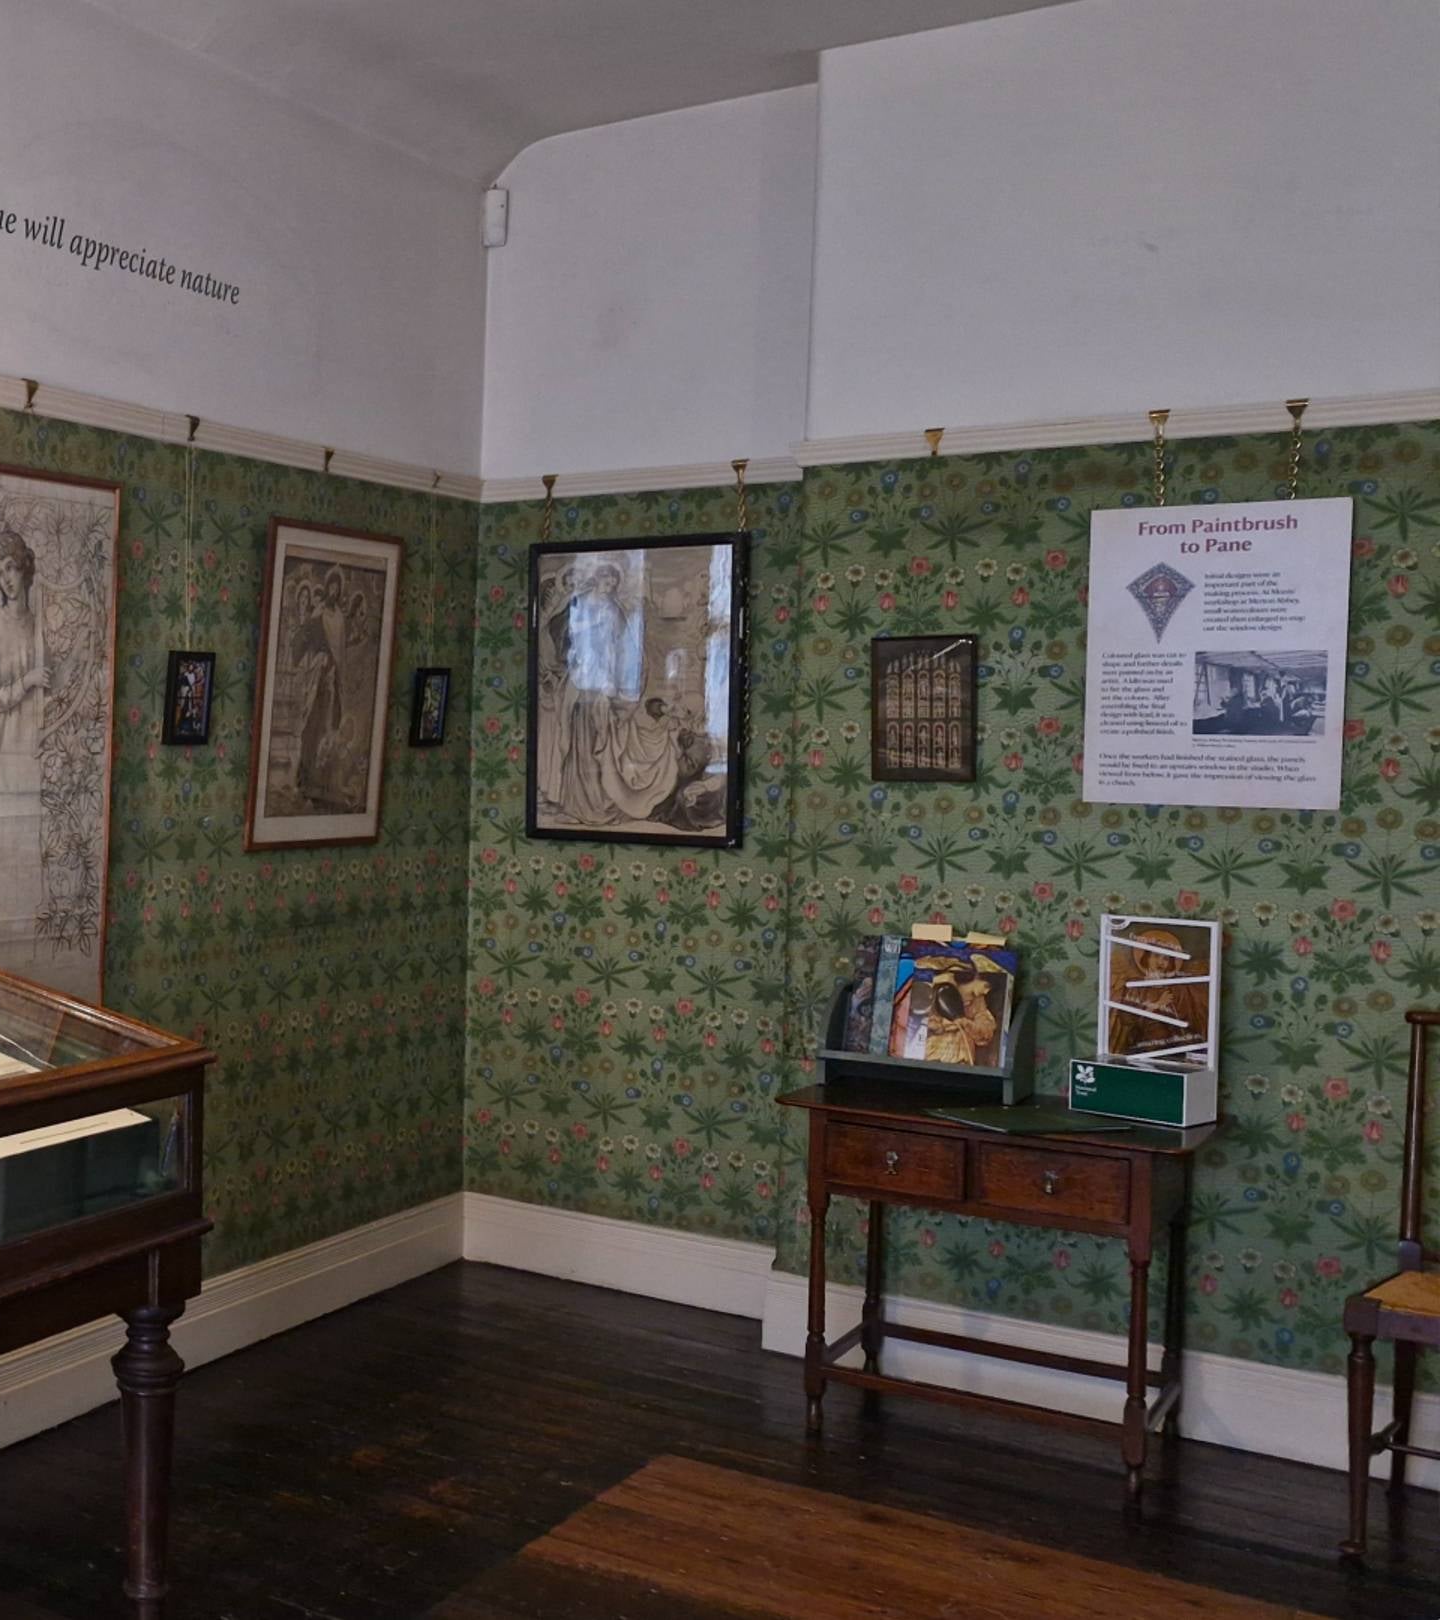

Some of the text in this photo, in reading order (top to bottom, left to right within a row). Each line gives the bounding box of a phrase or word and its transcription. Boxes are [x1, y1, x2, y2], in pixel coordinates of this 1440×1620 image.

[24, 216, 65, 250] will
[69, 232, 176, 284] appreciate
[181, 269, 240, 304] nature
[1138, 515, 1298, 536] From Paintbrush
[1180, 538, 1252, 554] to Pane
